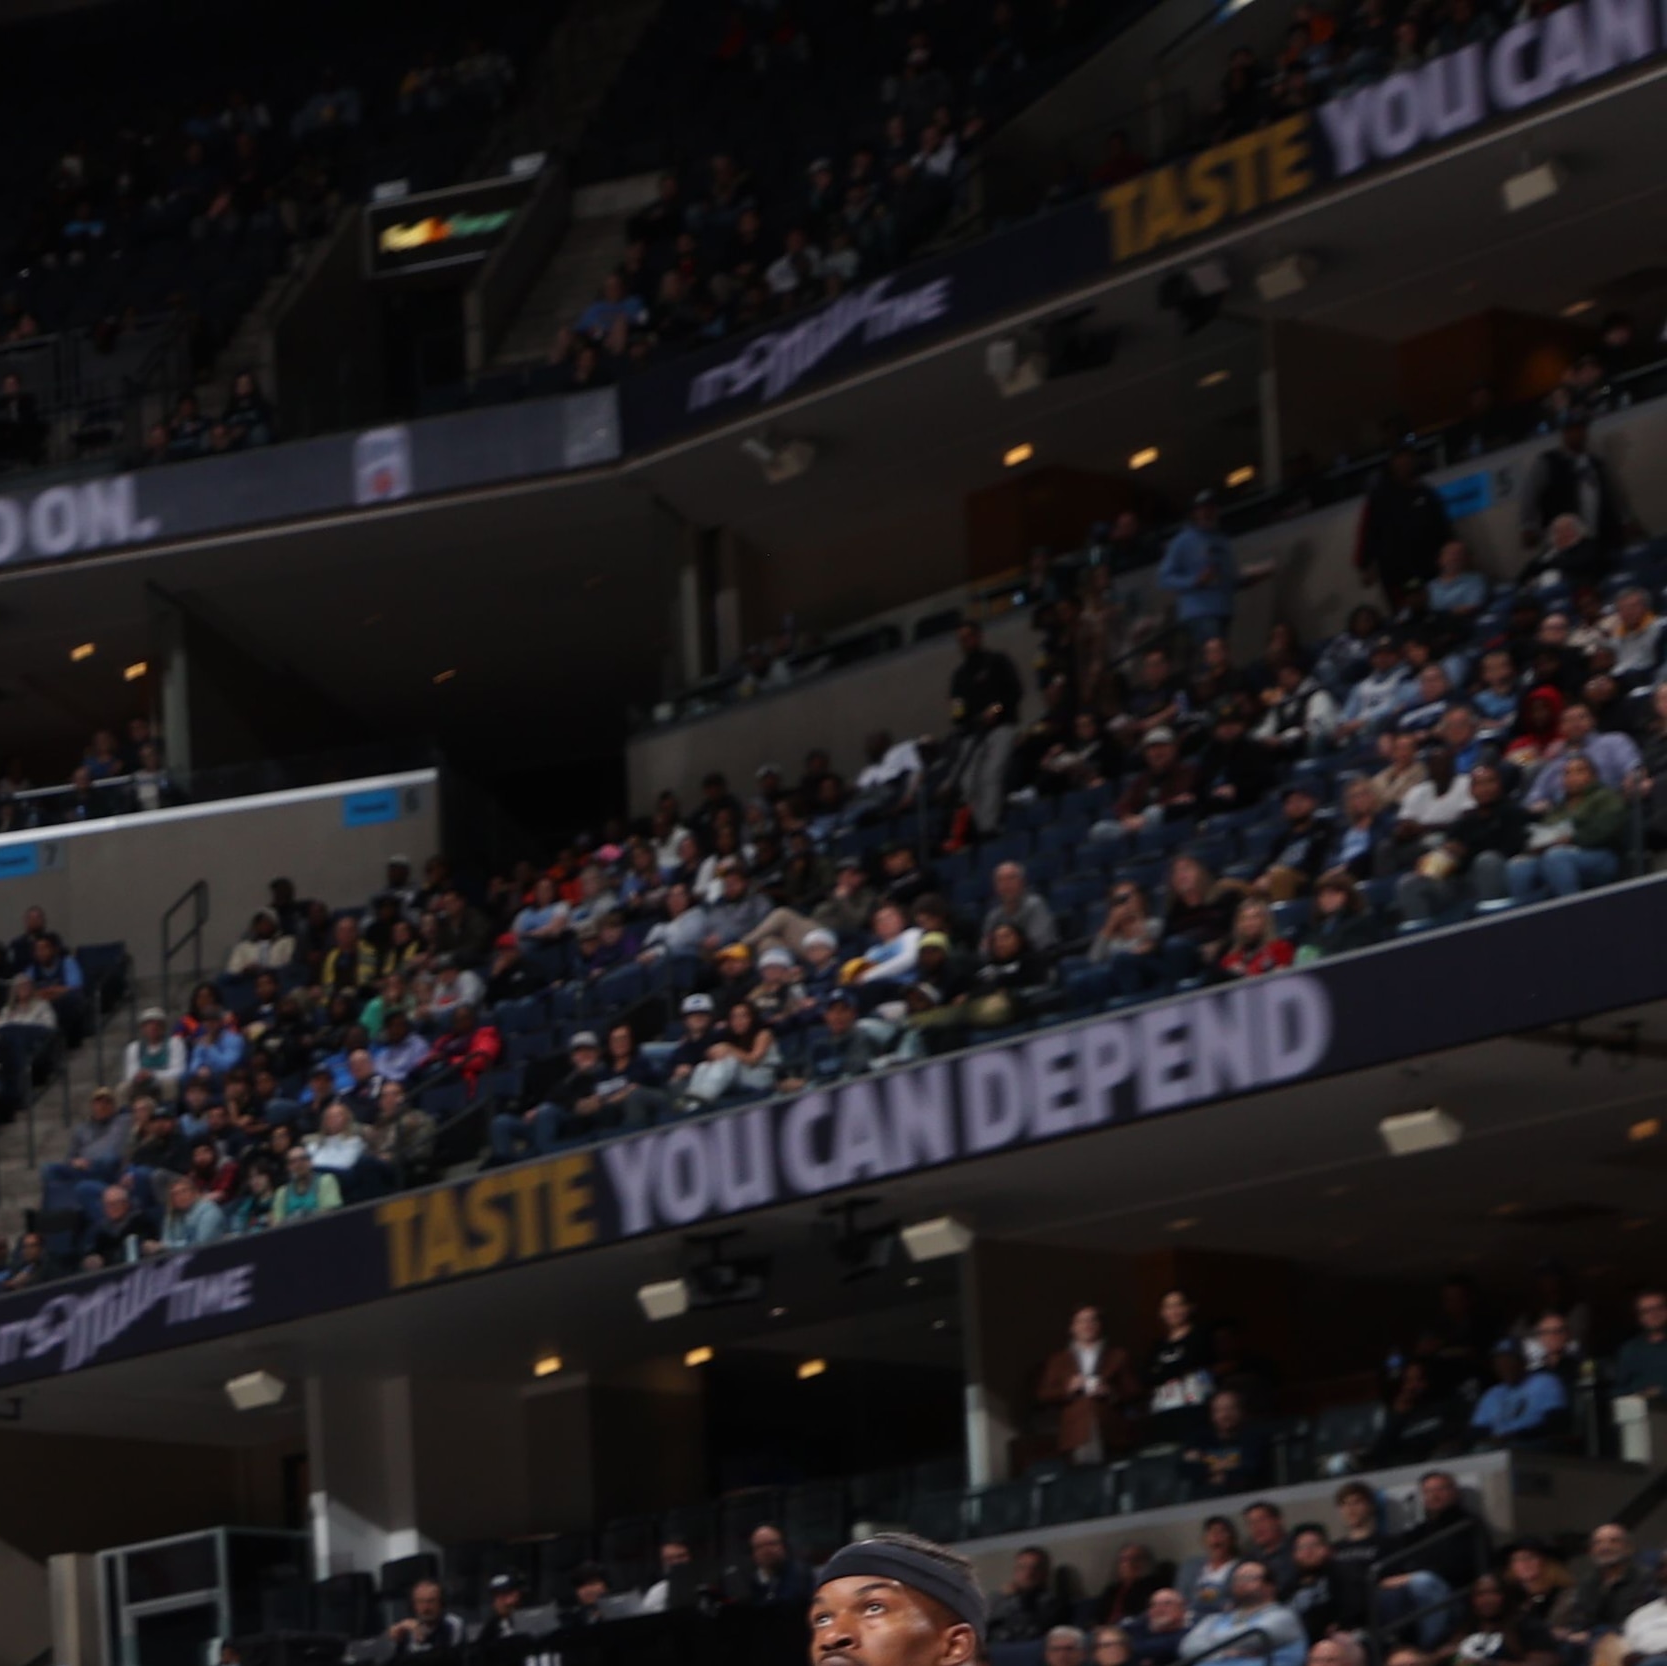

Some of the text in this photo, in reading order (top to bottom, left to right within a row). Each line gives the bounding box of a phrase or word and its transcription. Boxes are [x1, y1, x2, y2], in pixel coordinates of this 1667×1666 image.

[1098, 0, 1656, 262] TASTE YOU CAN
[24, 473, 164, 554] ON.
[374, 972, 1336, 1291] TASTE YOU CAN DEPEND
[164, 1261, 257, 1327] TIME
